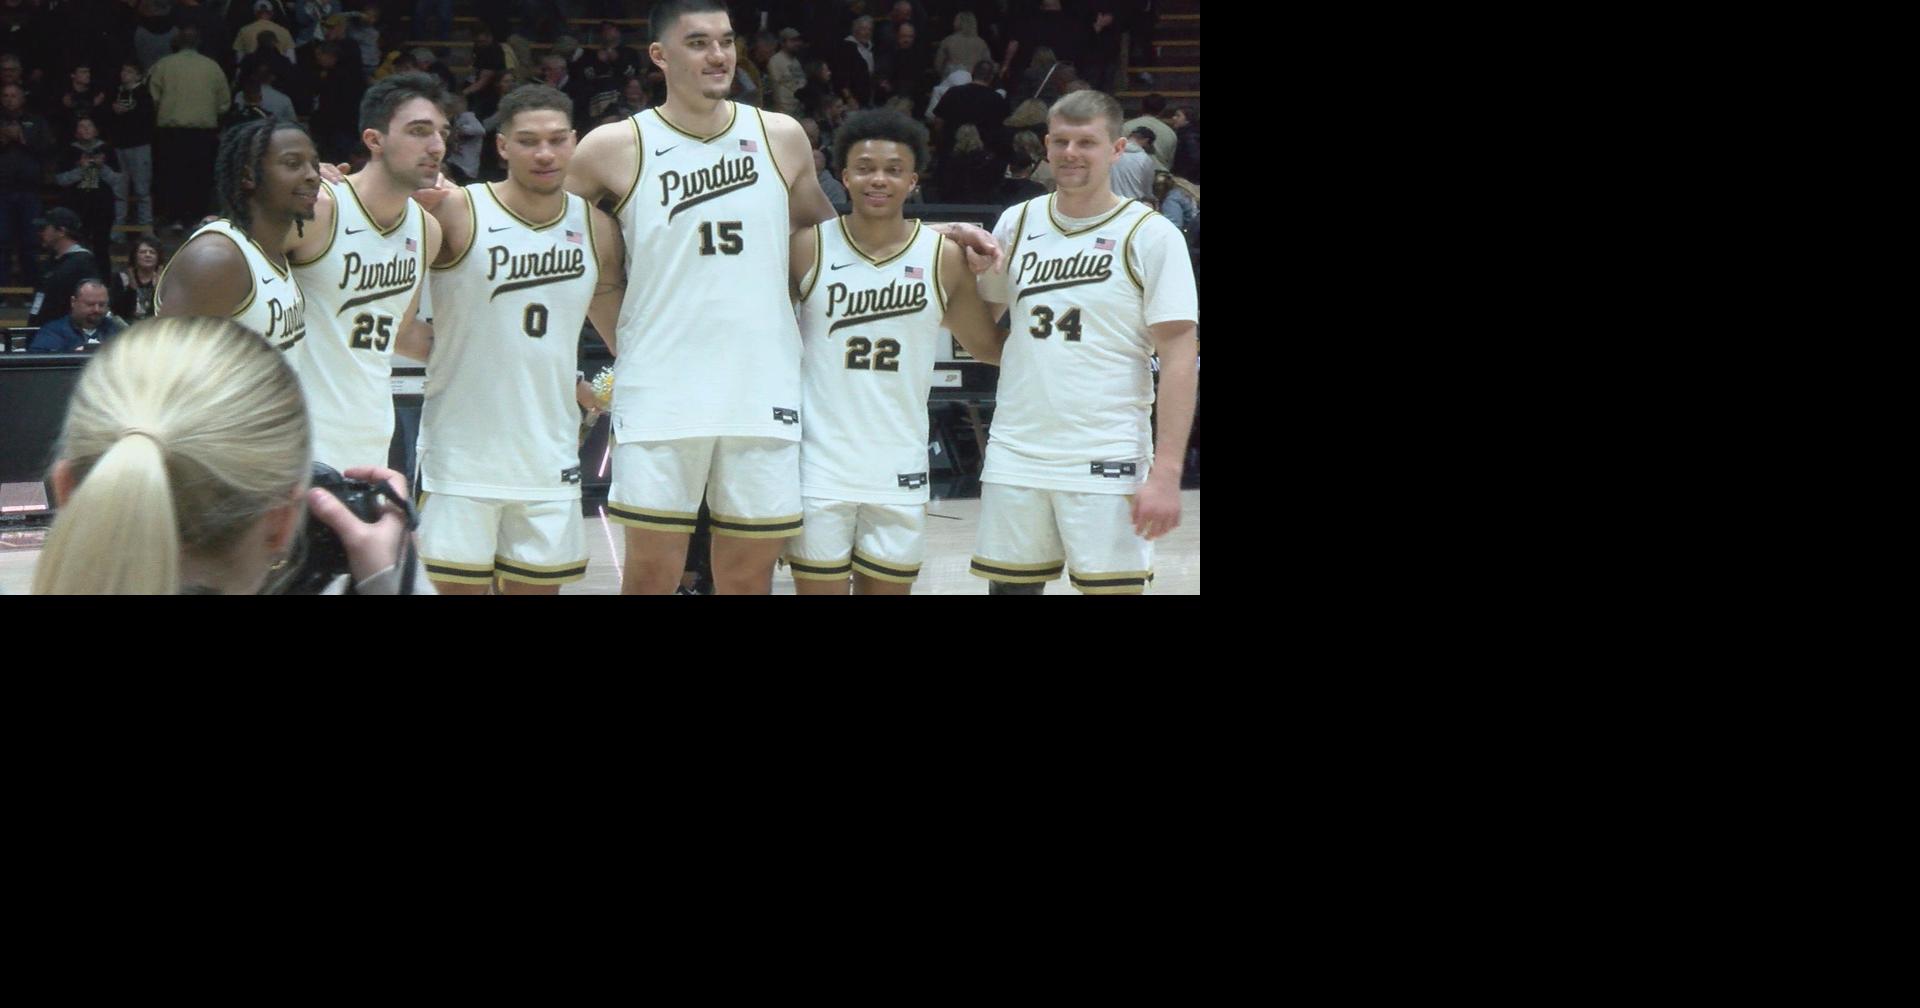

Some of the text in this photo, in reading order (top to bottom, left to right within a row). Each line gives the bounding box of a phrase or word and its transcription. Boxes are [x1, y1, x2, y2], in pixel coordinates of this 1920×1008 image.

[658, 154, 759, 207] Purdue
[699, 220, 744, 256] 15
[338, 252, 417, 293] Purdue
[486, 243, 586, 282] Purdue
[1016, 248, 1113, 286] Purdue
[825, 278, 928, 319] Purdue
[350, 312, 394, 352] 25
[523, 302, 549, 338] 0
[1028, 304, 1082, 342] 34
[844, 335, 901, 372] 22
